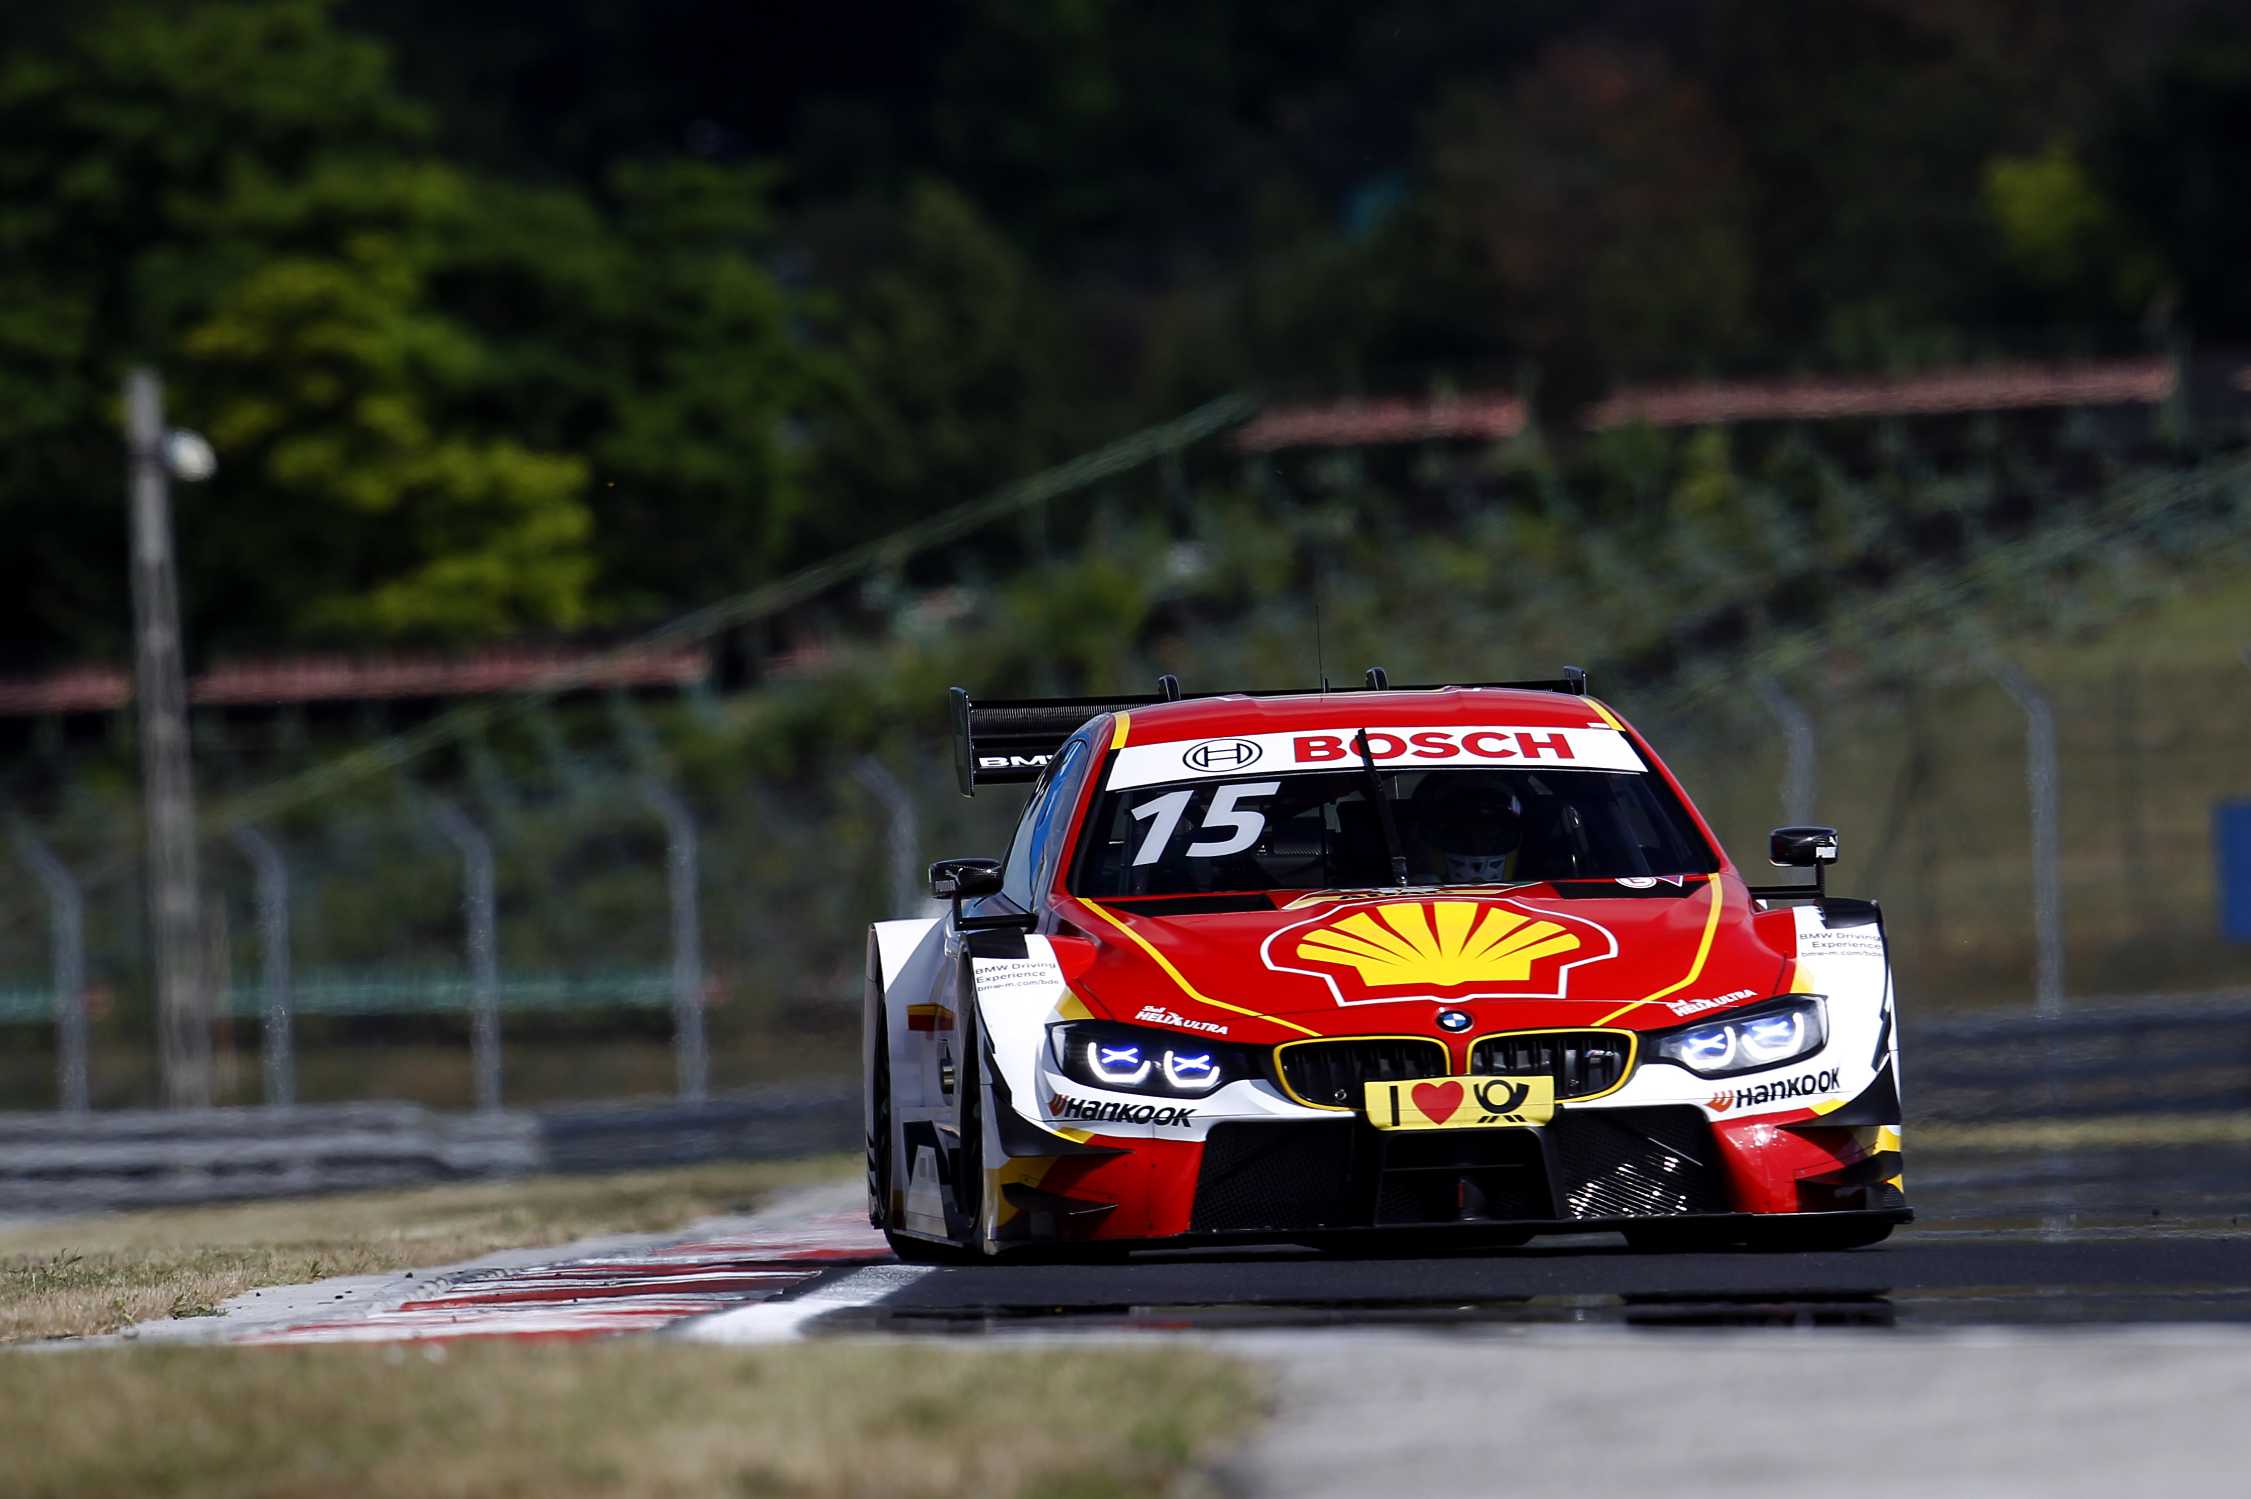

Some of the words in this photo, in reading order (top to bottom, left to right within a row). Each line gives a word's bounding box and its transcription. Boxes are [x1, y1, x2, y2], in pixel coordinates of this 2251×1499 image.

[1293, 731, 1576, 764] BOSCH
[979, 755, 1054, 769] BM
[1131, 782, 1281, 867] 15
[1800, 932, 1833, 940] BMW
[1836, 932, 1881, 942] Driving
[1811, 940, 1881, 950] Experience
[975, 964, 1009, 975] BMW
[1011, 962, 1057, 970] Driving
[976, 970, 1047, 984] Experience
[1134, 1010, 1184, 1027] HELIX
[1183, 1019, 1229, 1035] ULTRA
[1389, 1085, 1400, 1127] I
